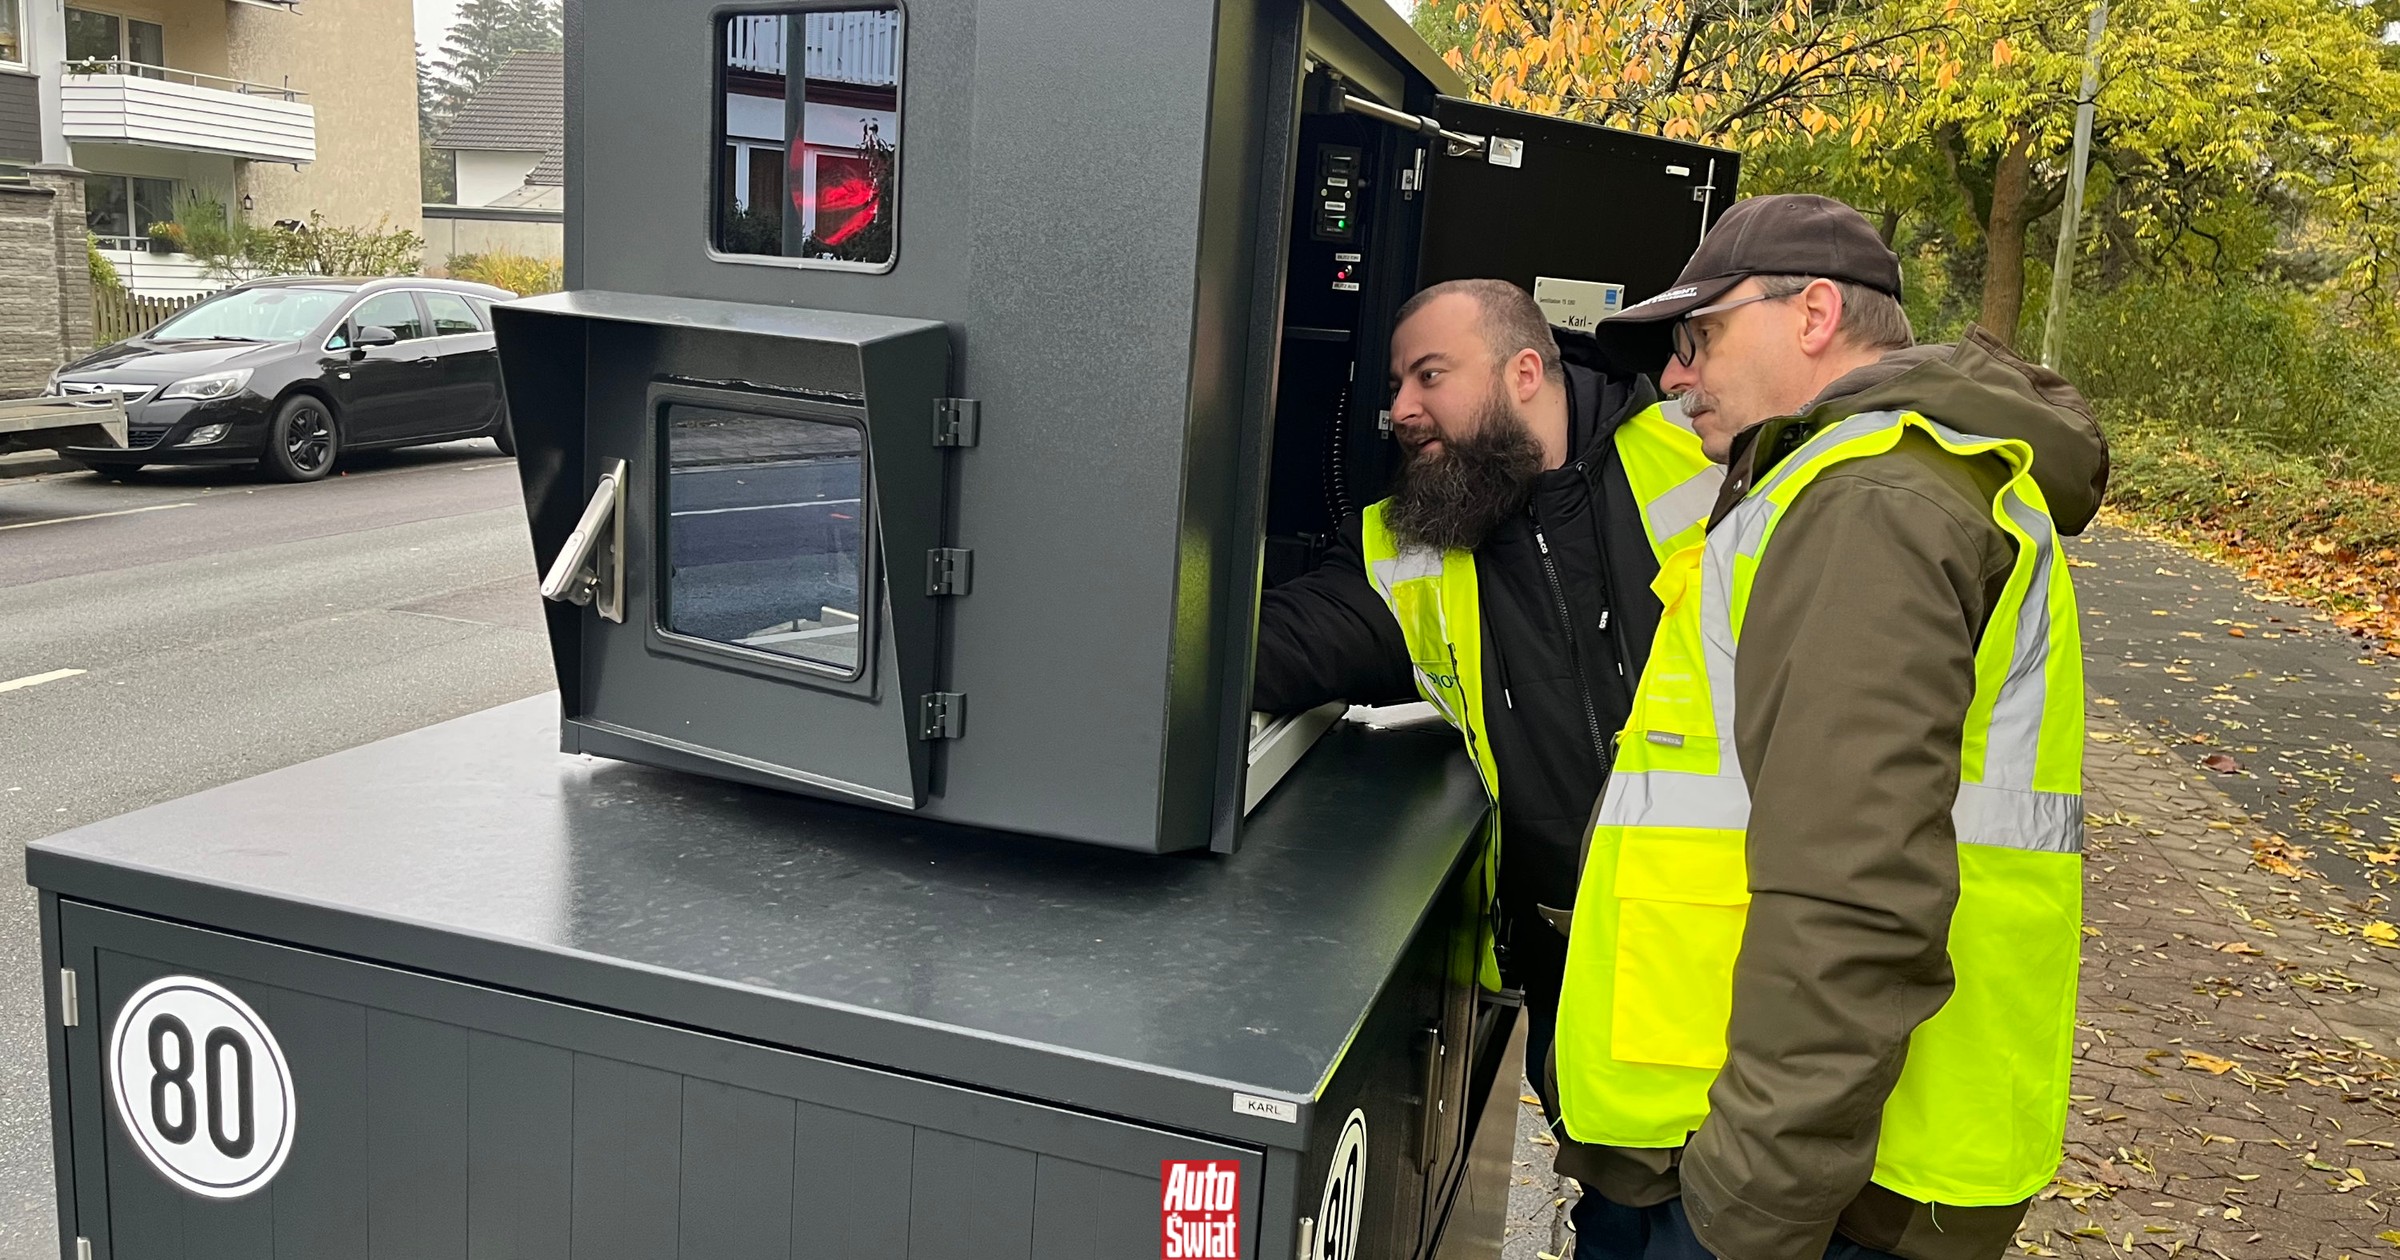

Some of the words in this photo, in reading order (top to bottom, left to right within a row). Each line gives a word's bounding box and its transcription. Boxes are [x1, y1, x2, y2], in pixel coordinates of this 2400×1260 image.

[1568, 315, 1587, 328] Karl
[147, 1013, 255, 1160] 80
[1248, 1100, 1281, 1115] KARL
